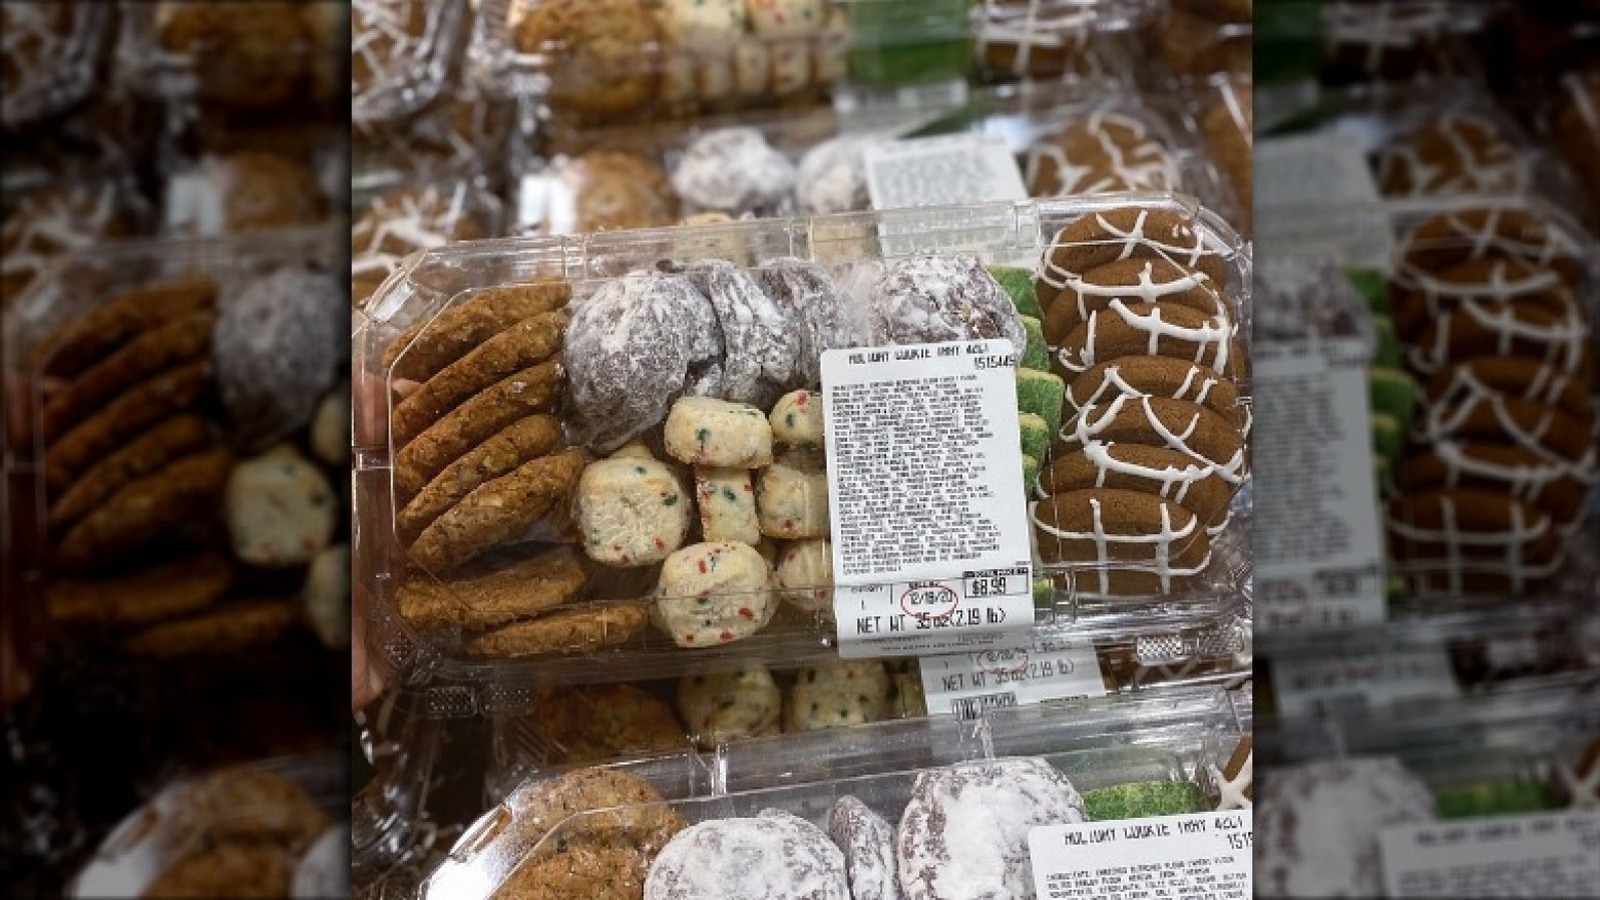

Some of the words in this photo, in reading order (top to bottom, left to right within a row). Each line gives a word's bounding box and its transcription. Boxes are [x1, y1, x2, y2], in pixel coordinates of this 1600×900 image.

[972, 577, 1006, 596] $8.99
[857, 615, 881, 635] NET
[890, 614, 906, 631] WT
[941, 673, 963, 692] NET
[972, 671, 986, 688] WT
